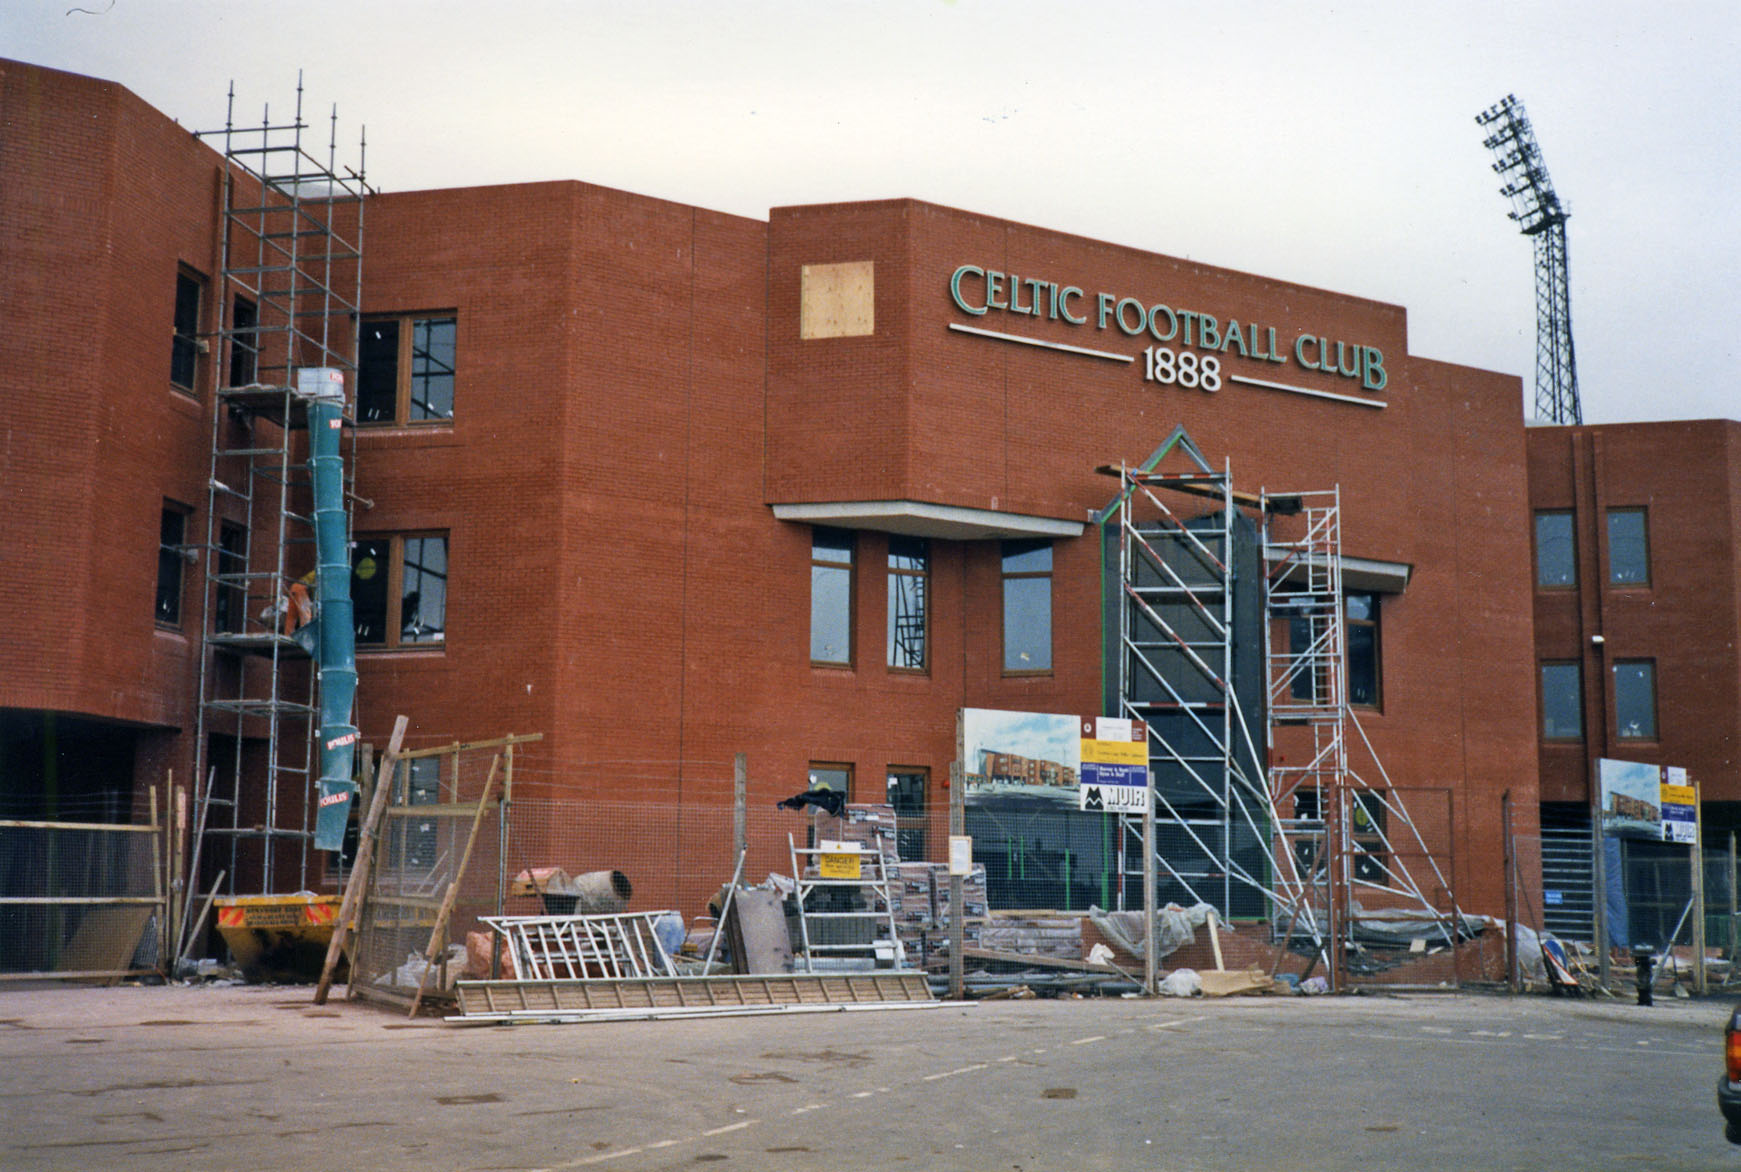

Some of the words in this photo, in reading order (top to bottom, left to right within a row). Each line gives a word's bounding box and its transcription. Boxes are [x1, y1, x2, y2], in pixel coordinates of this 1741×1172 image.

[950, 265, 1087, 326] CELTIC
[1097, 292, 1288, 363] FOOTBALL
[1295, 334, 1388, 390] CLUB
[1143, 346, 1222, 392] 1888
[1105, 787, 1146, 807] MUIR
